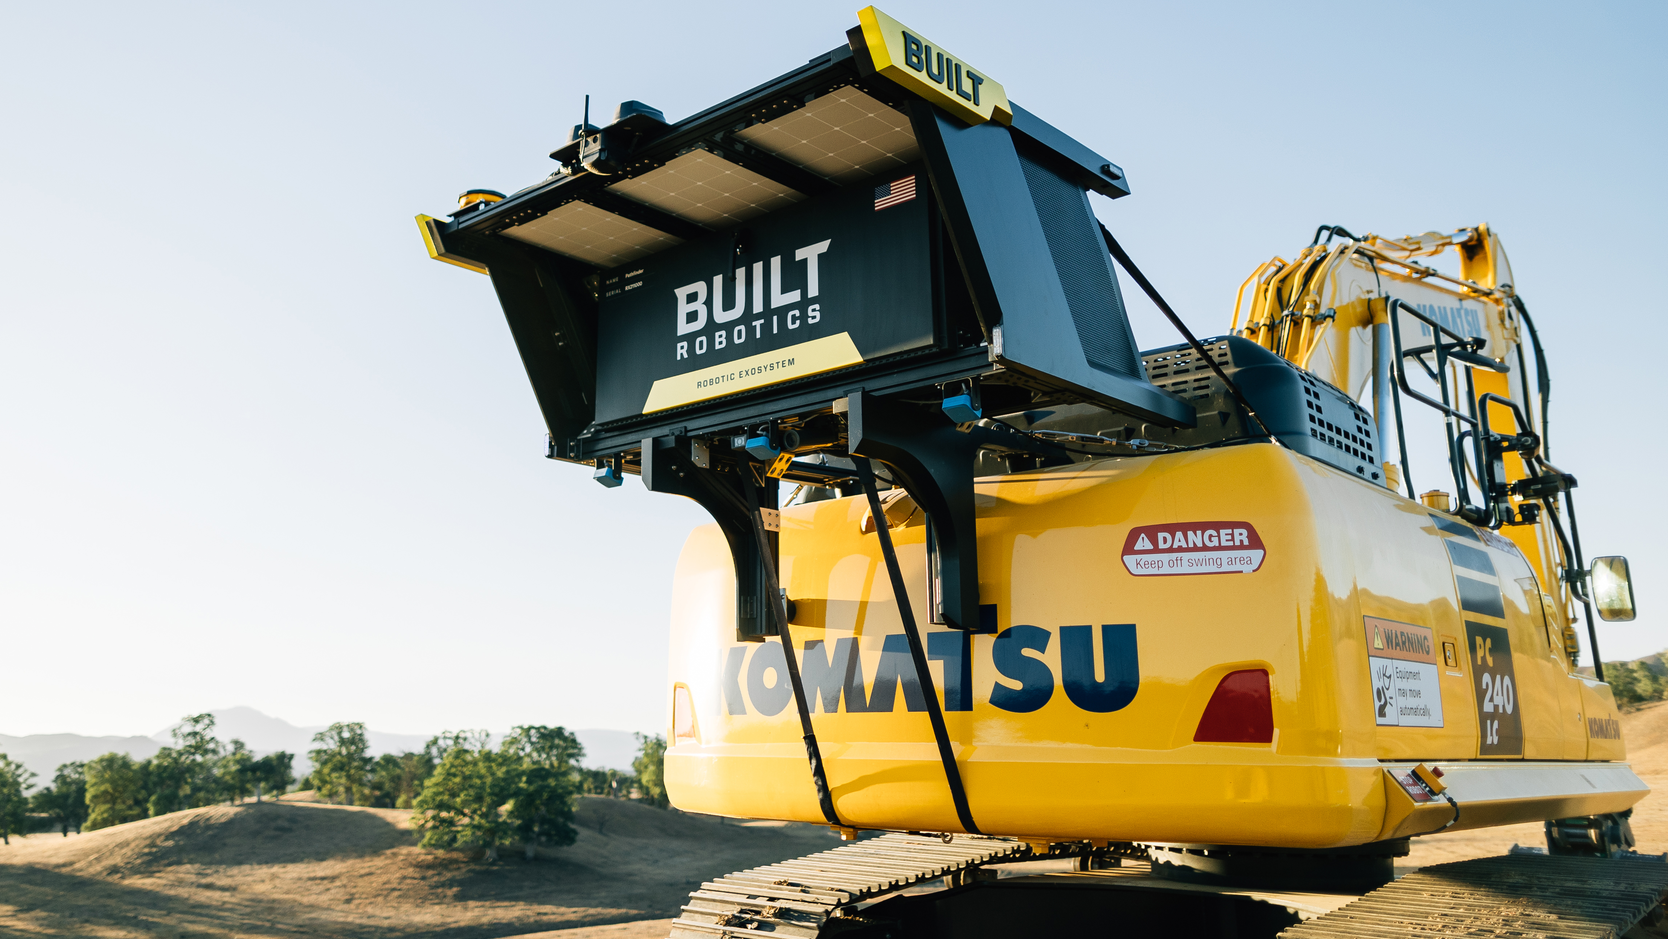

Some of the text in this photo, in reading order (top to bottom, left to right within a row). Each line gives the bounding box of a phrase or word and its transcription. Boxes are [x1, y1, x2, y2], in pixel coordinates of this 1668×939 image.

[901, 30, 984, 107] BUILT
[605, 289, 621, 297] SERIAL
[674, 238, 832, 337] BUILT
[676, 303, 821, 361] ROBOTICS
[1416, 298, 1482, 338] KOMATSU
[696, 357, 796, 389] ROBOTIC EXOSYSTEM
[1157, 528, 1250, 549] DANGER
[1135, 555, 1253, 571] Keep off swing area
[1383, 627, 1431, 655] WARNING
[1475, 635, 1494, 667] PC
[717, 603, 1140, 716] KOMATSU
[1395, 666, 1421, 682] Equipment
[1397, 688, 1422, 700] may move
[1482, 672, 1514, 715] 240
[1486, 720, 1498, 745] LC
[1587, 713, 1621, 740] KOMATSU
